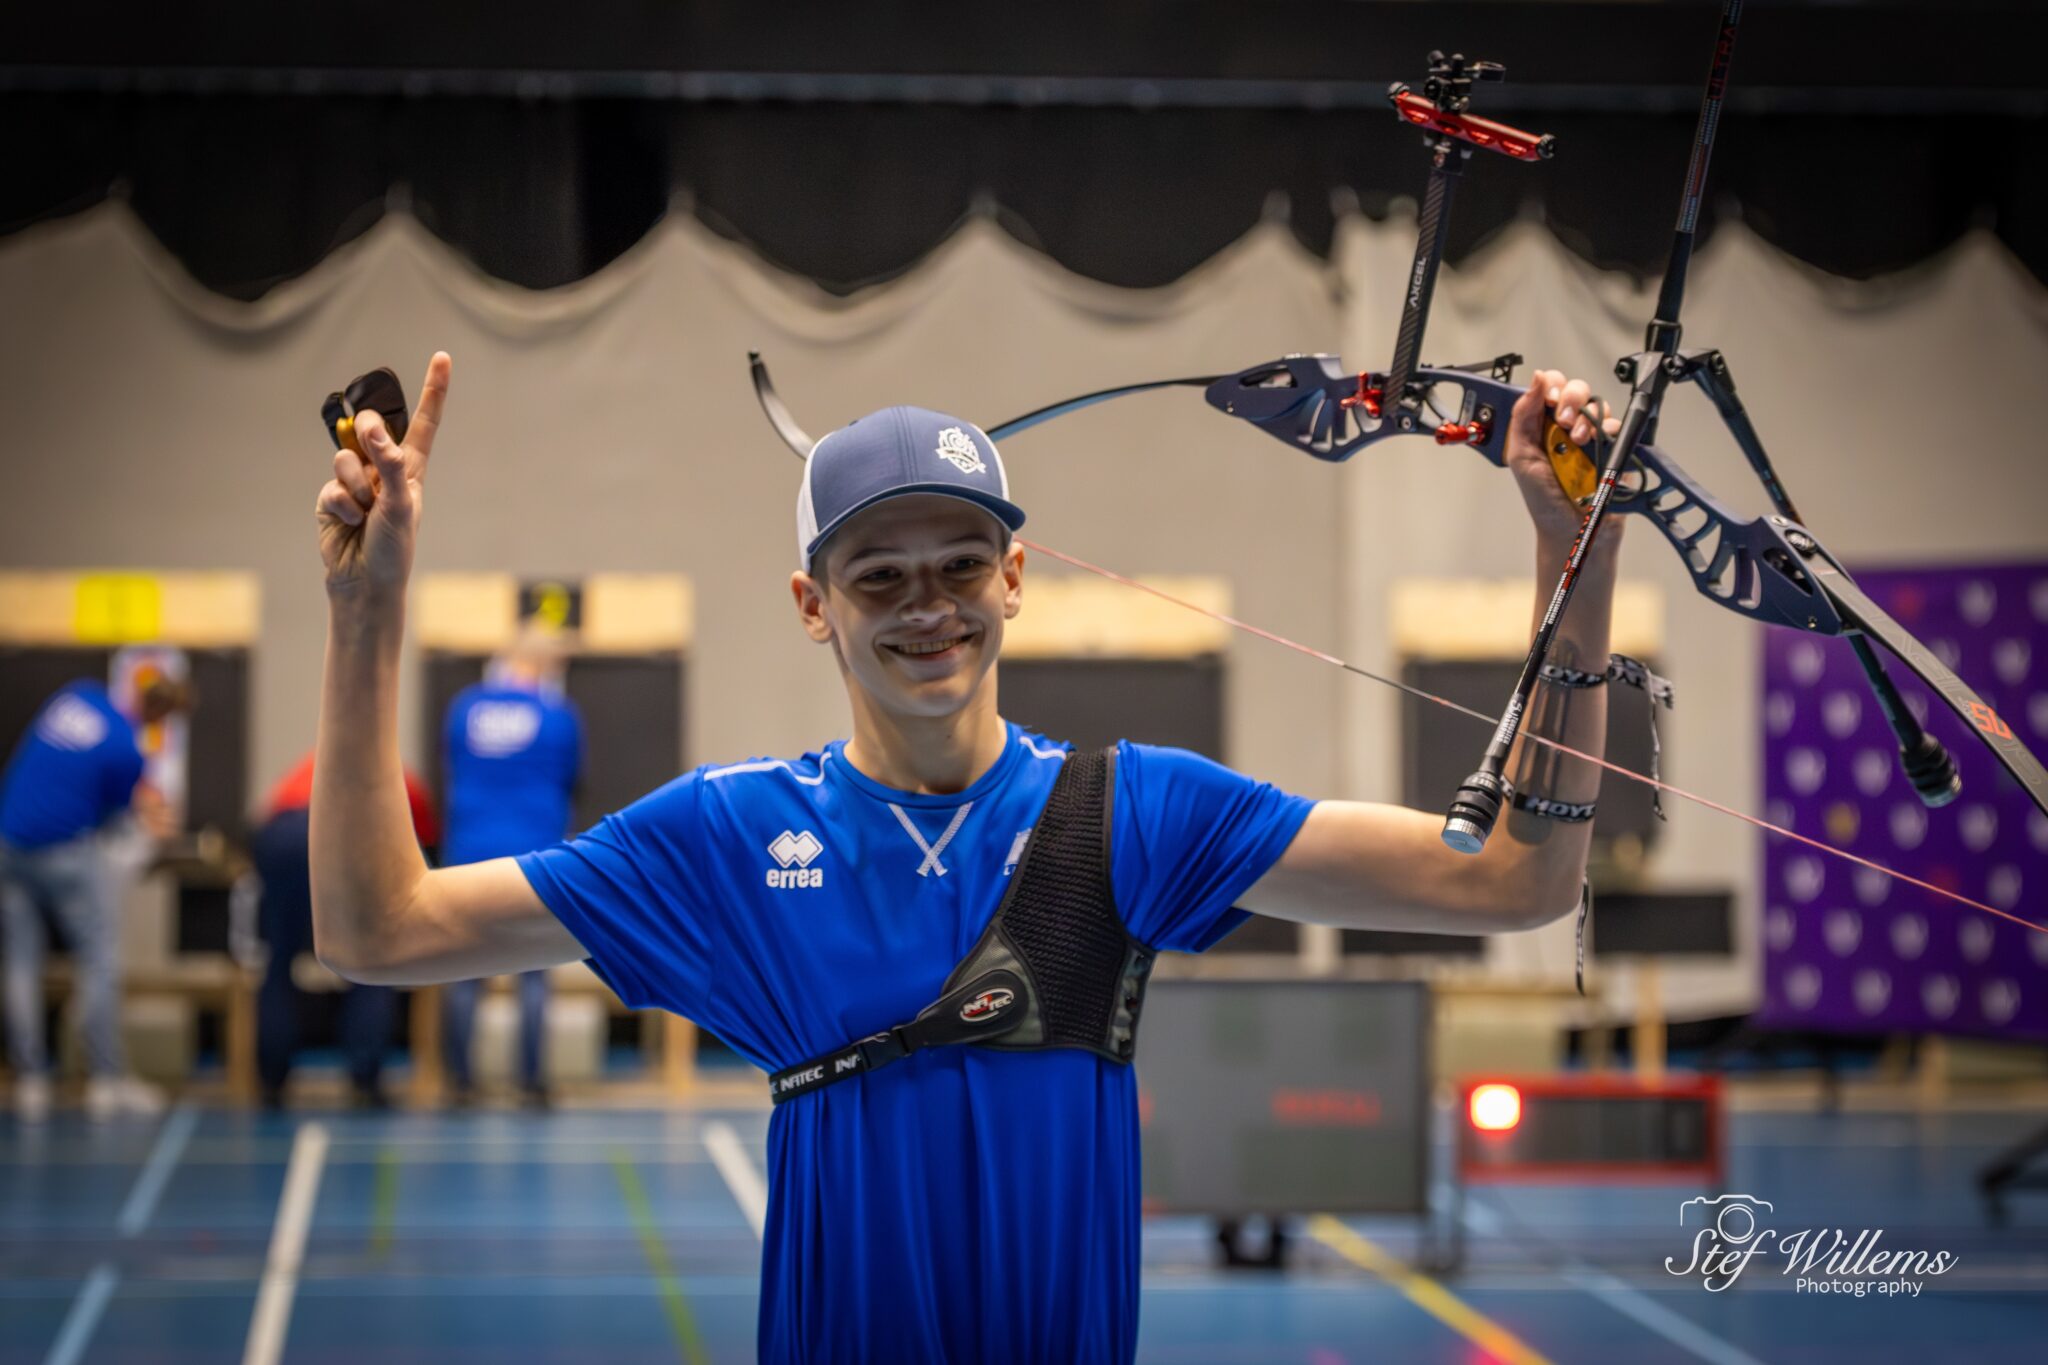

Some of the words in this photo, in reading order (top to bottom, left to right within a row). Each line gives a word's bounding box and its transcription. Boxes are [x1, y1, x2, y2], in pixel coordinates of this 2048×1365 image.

[1409, 257, 1427, 307] AXCEL
[1525, 797, 1597, 818] HOYT
[766, 868, 823, 889] errea
